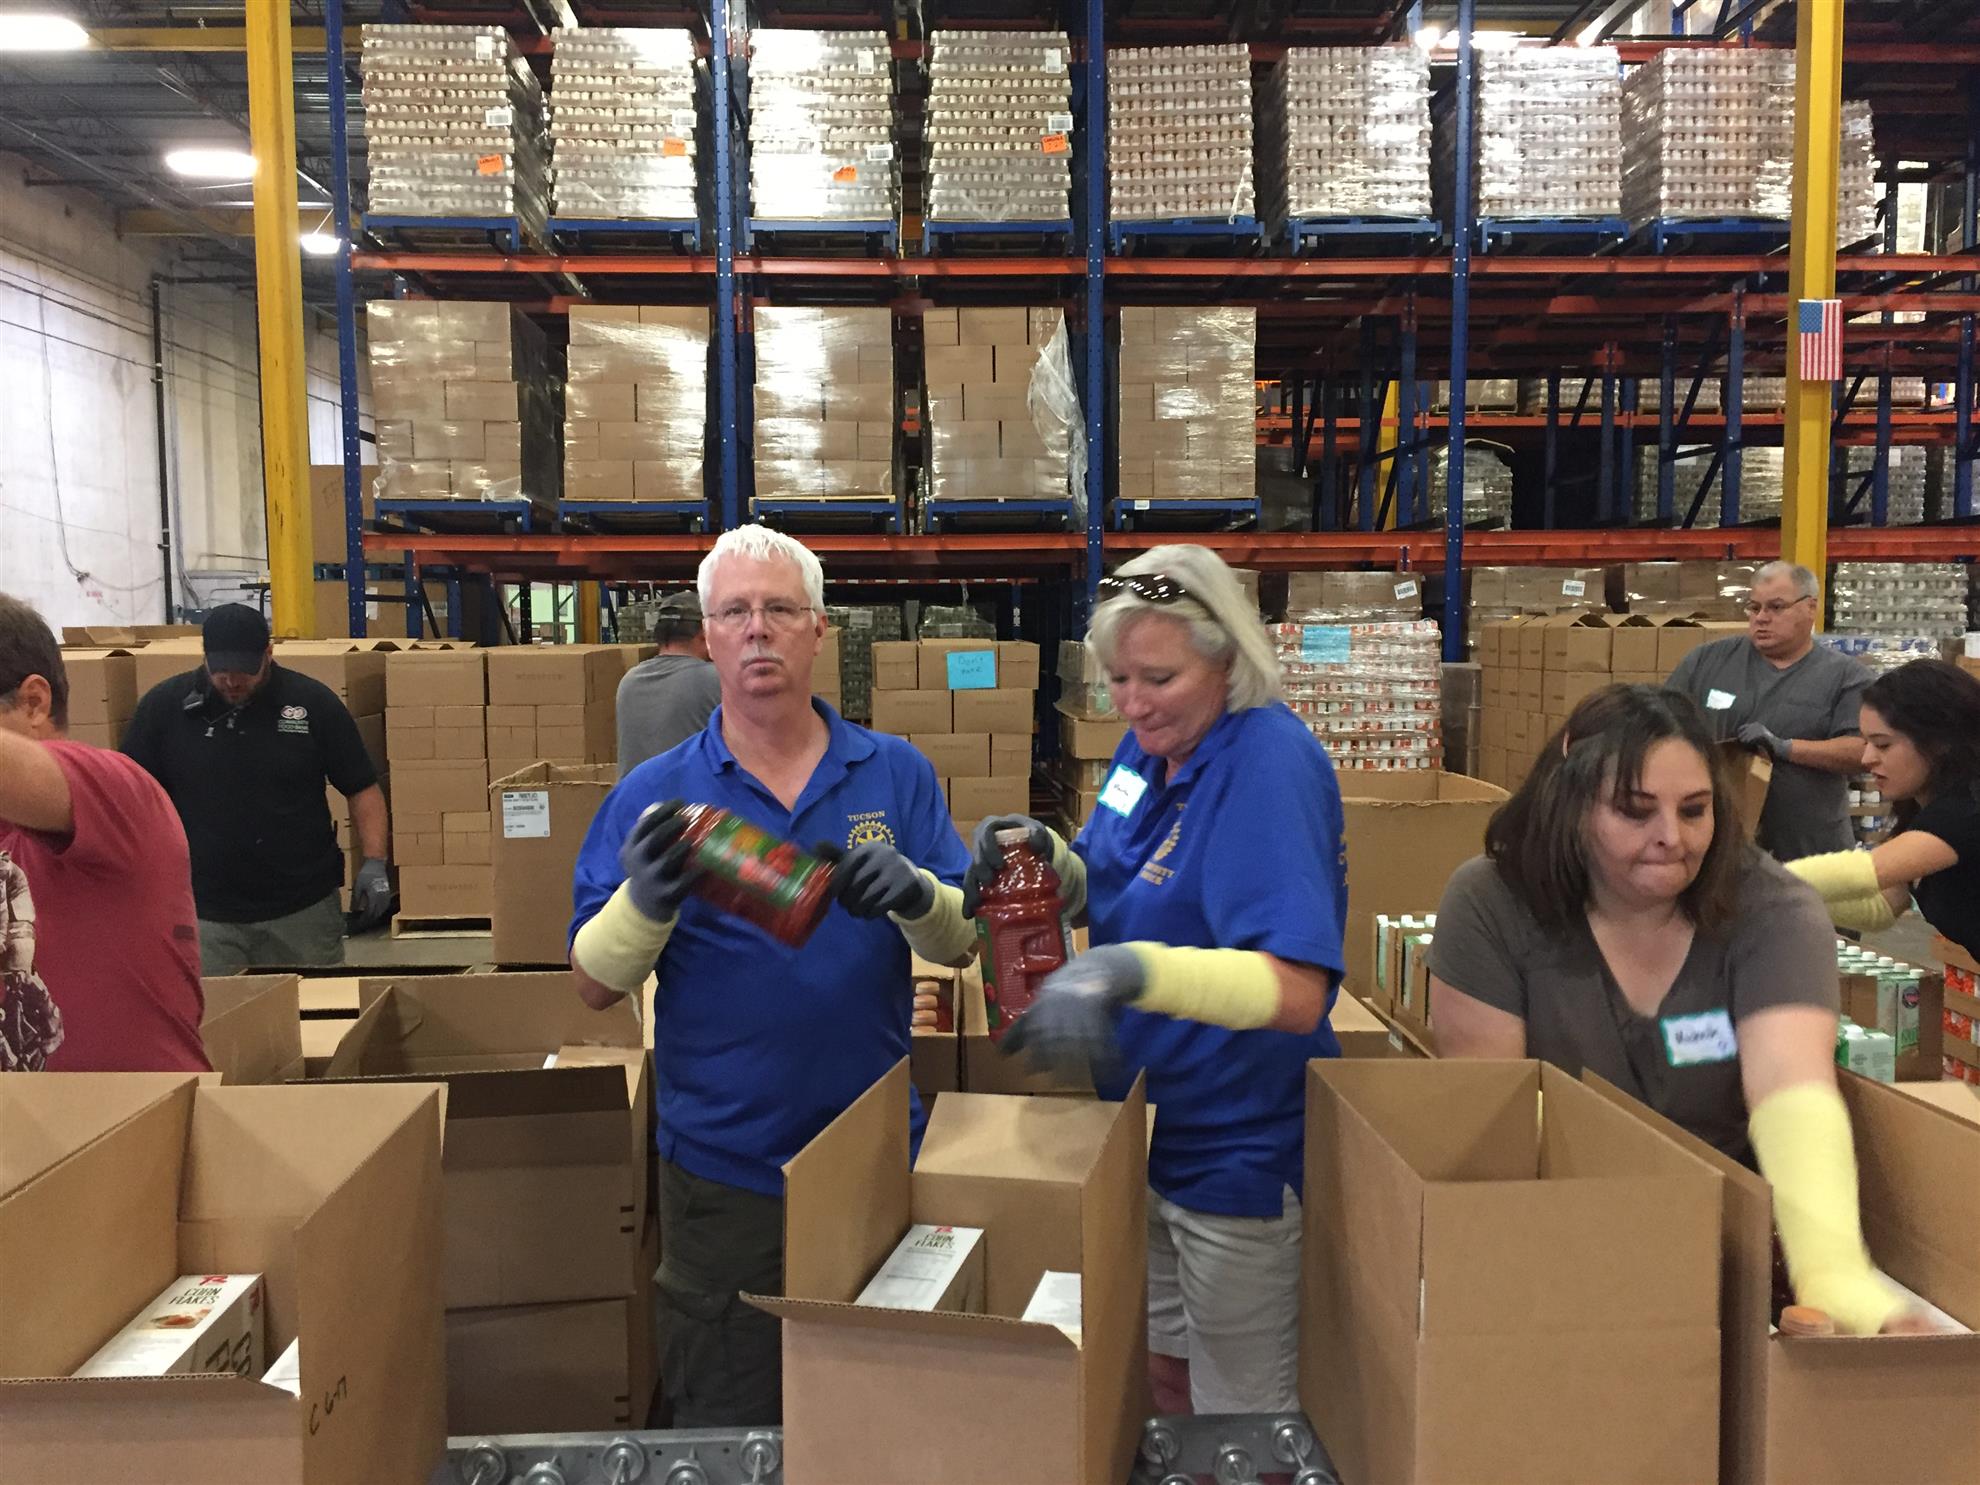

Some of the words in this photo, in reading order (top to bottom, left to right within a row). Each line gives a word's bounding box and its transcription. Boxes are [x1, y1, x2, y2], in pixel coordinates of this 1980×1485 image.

[847, 810, 885, 822] TUCSON
[184, 1287, 223, 1297] CORN
[168, 1296, 219, 1305] FLAKES
